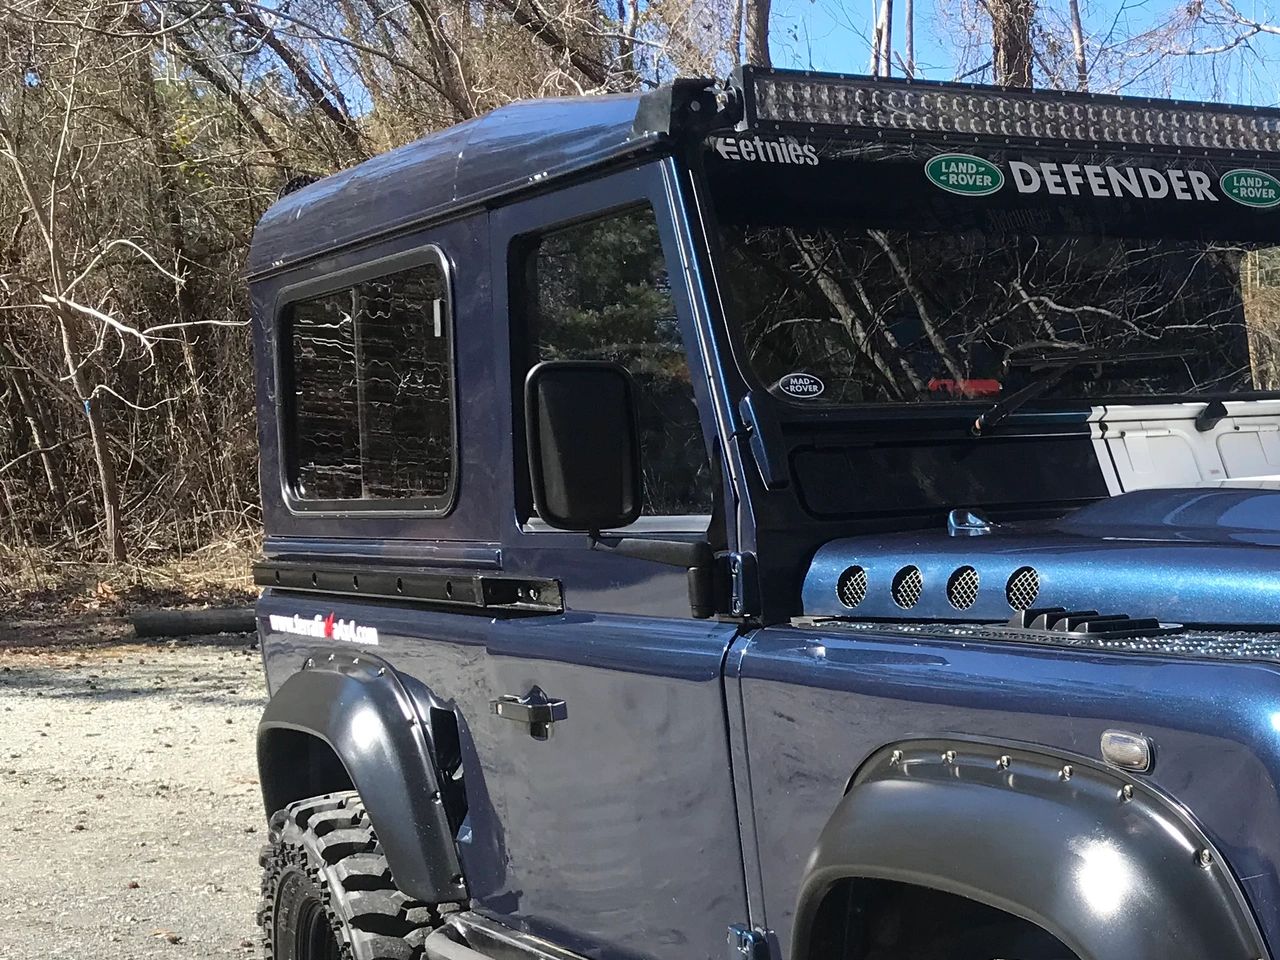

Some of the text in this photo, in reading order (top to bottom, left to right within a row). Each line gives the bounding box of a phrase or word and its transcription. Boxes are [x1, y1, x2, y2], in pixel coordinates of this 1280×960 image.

[941, 161, 977, 174] LAND
[948, 173, 992, 187] ROVER
[1008, 160, 1219, 201] DEFENDER
[1233, 175, 1263, 187] LAND
[1240, 186, 1276, 199] ROVER
